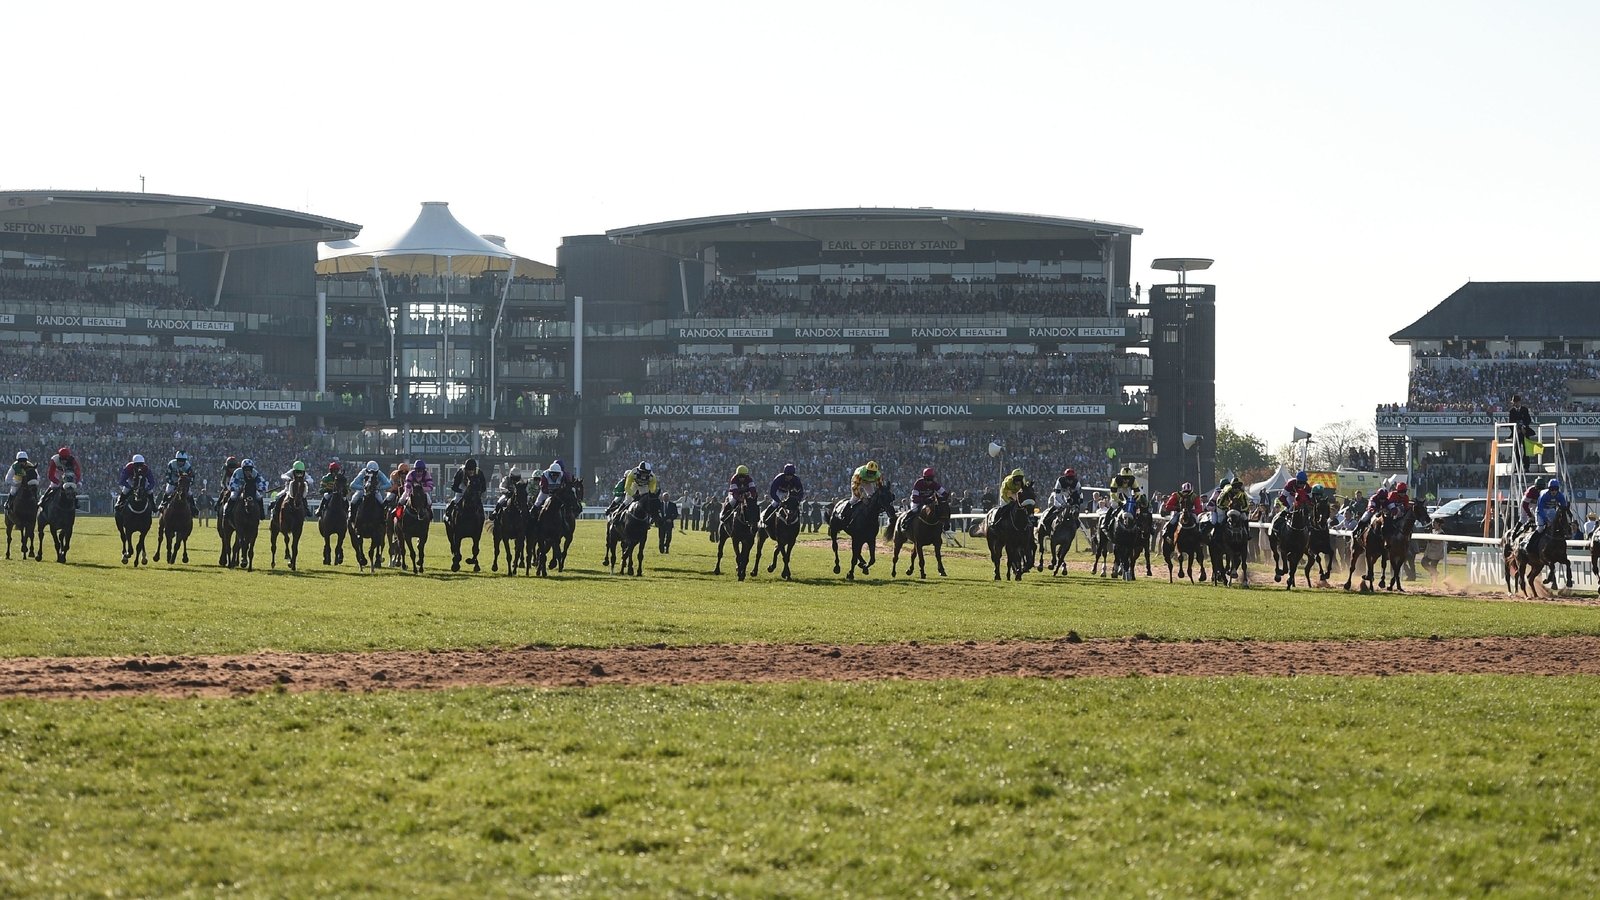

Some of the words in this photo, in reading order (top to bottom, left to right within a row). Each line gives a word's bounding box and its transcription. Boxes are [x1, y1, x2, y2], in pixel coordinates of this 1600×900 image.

[3, 222, 45, 233] SEFTON
[49, 224, 86, 235] STAND
[828, 240, 857, 250] EARL
[861, 240, 877, 250] OF
[880, 239, 915, 250] DERBY
[920, 239, 958, 249] STAND
[36, 315, 81, 326] RANDOX
[87, 318, 122, 326] HEALTH
[147, 319, 190, 330] RANDOX
[196, 322, 230, 330] HEALTH
[680, 328, 725, 338] RANDOX
[732, 329, 769, 337] HEALTH
[795, 328, 841, 338] RANDOX
[848, 329, 884, 337] HEALTH
[911, 328, 957, 337] RANDOX
[1029, 328, 1076, 337] RANDOX
[45, 397, 80, 405] HEALTH
[88, 397, 126, 407] GRAND
[127, 398, 181, 409] NATIONAL
[213, 400, 257, 410] RANDOX
[263, 402, 297, 410] HEALTH
[644, 405, 691, 415] RANDOX
[697, 406, 734, 414] HEALTH
[774, 405, 821, 415] RANDOX
[829, 406, 866, 414] HEALTH
[873, 405, 912, 415] GRAND
[914, 405, 972, 415] NATIONAL
[1007, 405, 1055, 415] RANDOX
[1062, 406, 1100, 414] HEALTH
[1378, 416, 1417, 424] RANDOX
[1459, 416, 1492, 424] GRAND
[1493, 416, 1540, 424] NATAL
[1561, 416, 1600, 424] RANDOX
[410, 433, 470, 445] RANDOX
